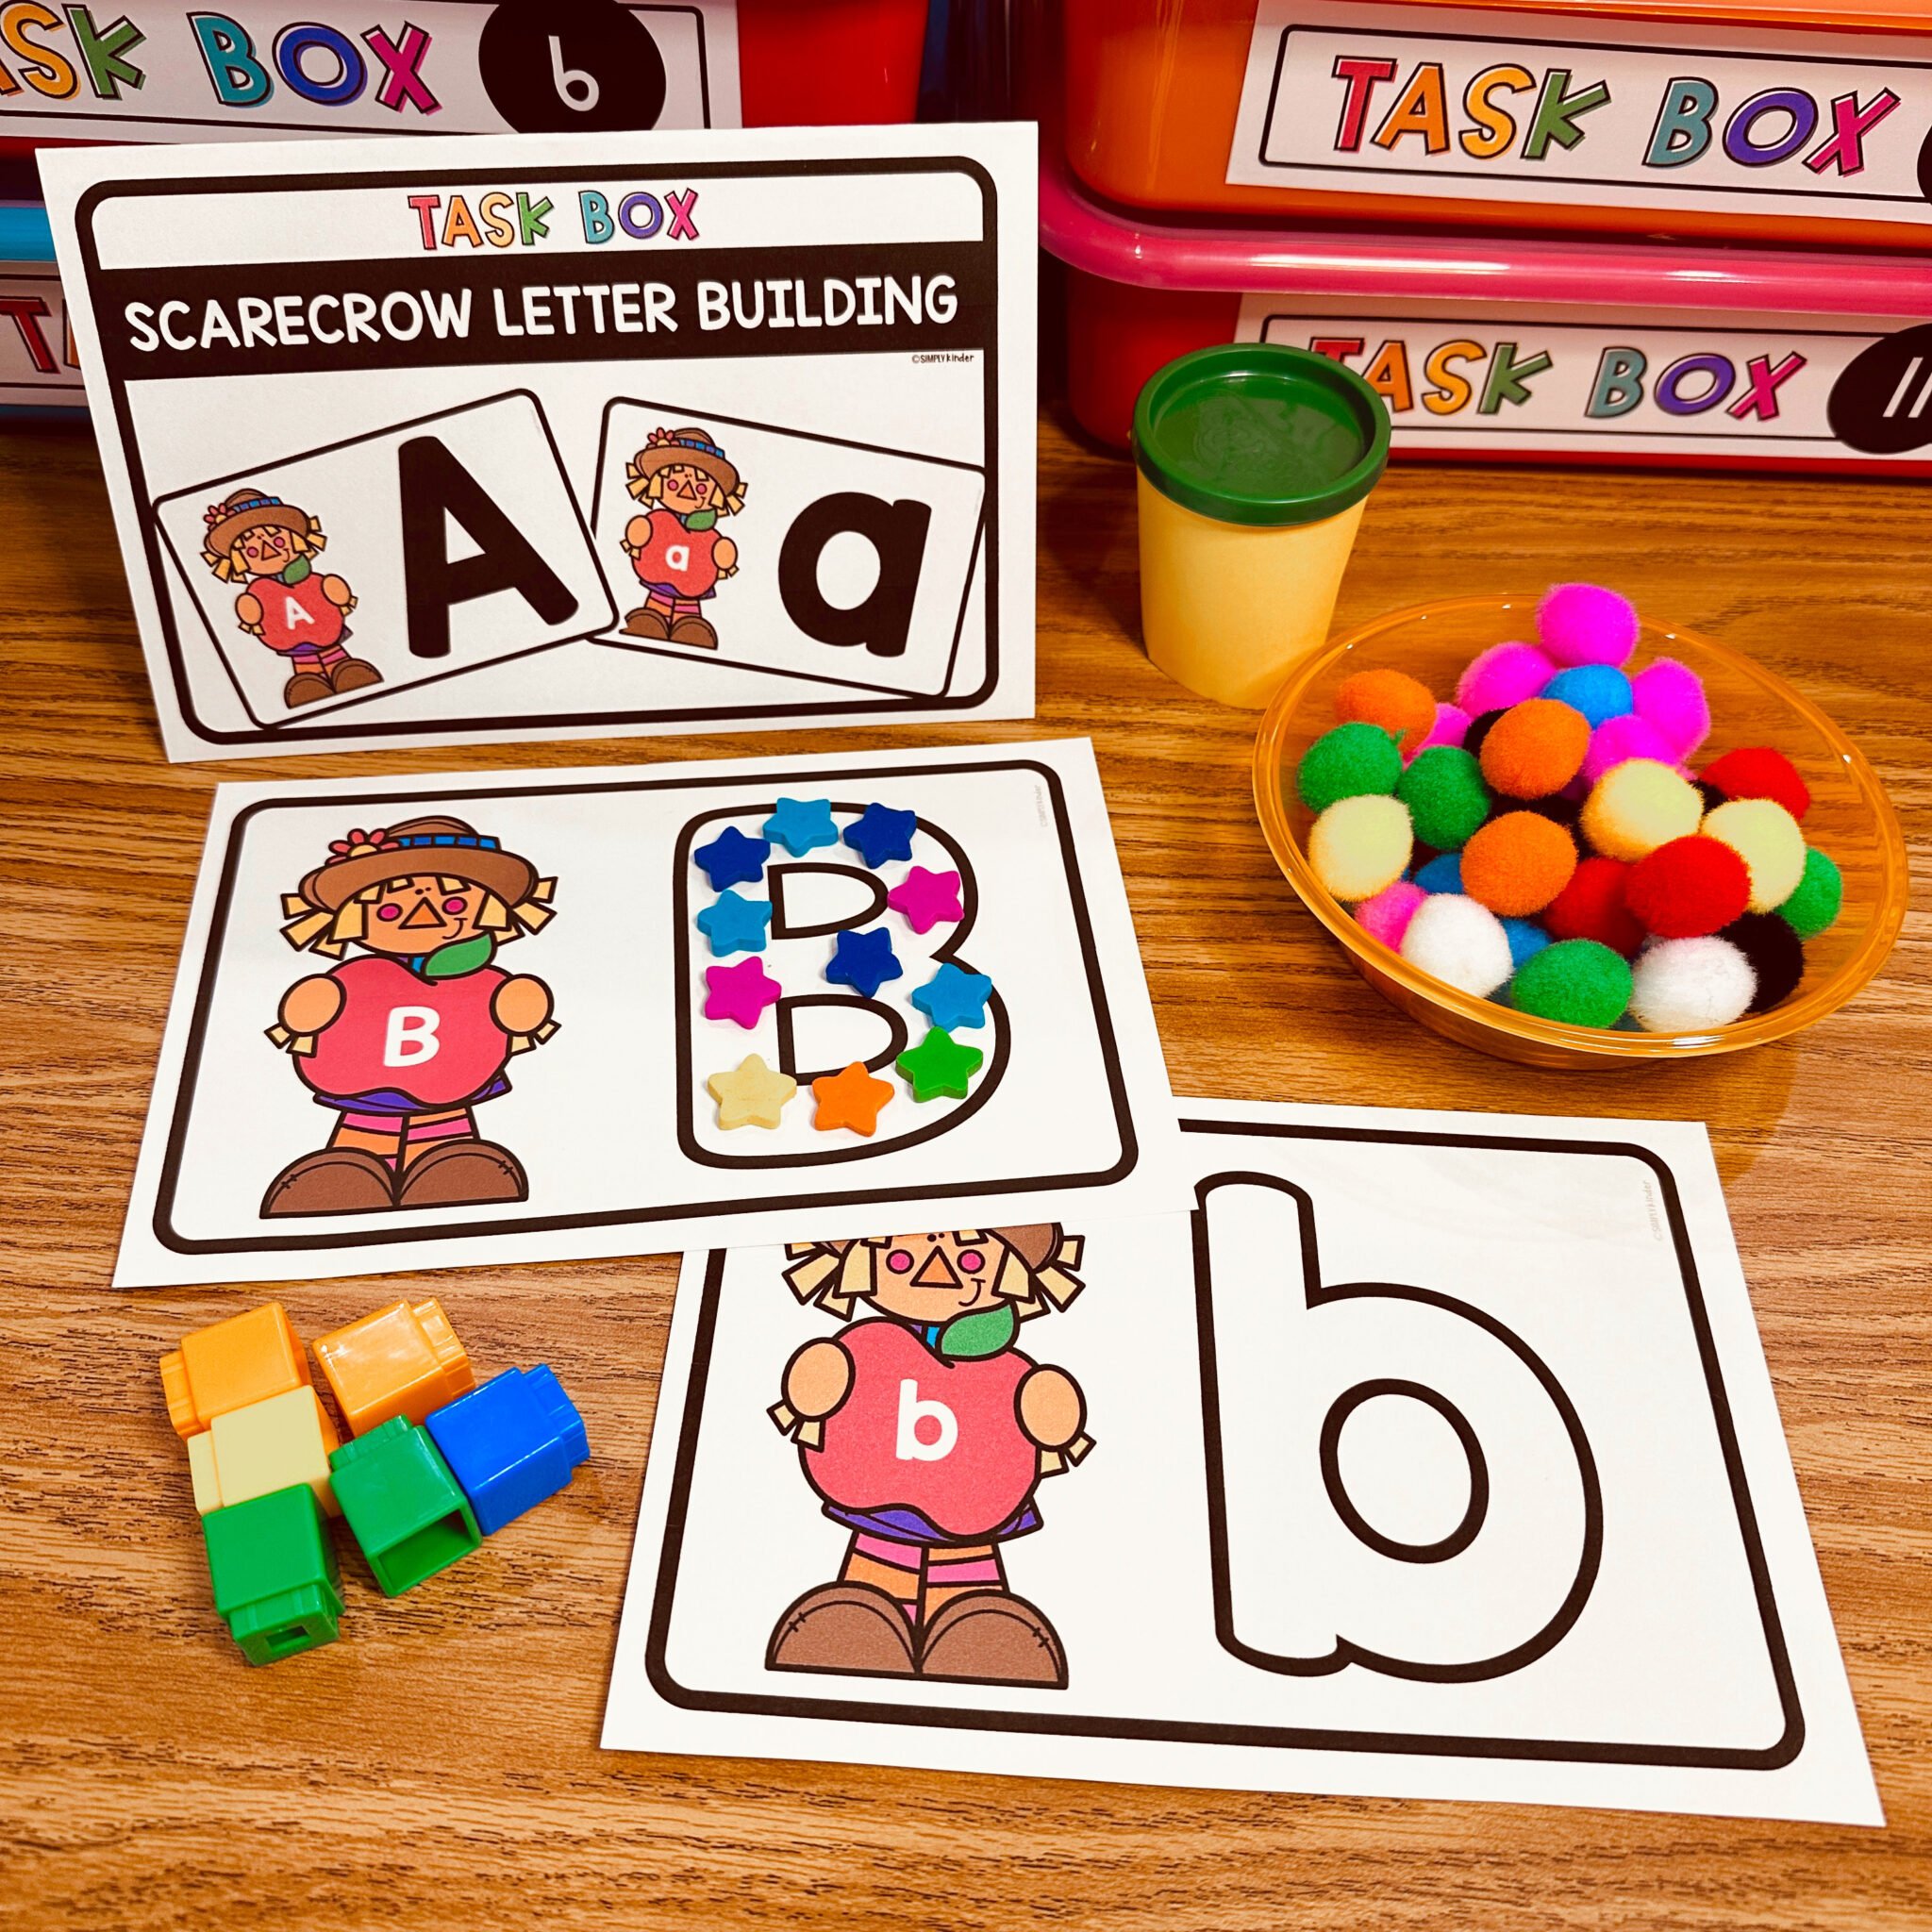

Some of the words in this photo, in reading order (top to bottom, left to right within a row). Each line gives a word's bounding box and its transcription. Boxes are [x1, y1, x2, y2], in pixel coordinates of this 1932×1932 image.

[0, 0, 147, 101] SK
[187, 11, 441, 114] BOX
[1331, 56, 1611, 161] TASK
[1641, 76, 1902, 176] BOX
[408, 191, 554, 250] TASK
[579, 188, 699, 245] BOX
[125, 288, 472, 352] SCARECROW
[493, 281, 678, 338] LETTER
[697, 275, 958, 330] BUILDING
[1584, 346, 1807, 422] BOX
[397, 435, 579, 658] A
[665, 541, 690, 574] a
[777, 491, 933, 658] a
[284, 595, 315, 632] A
[674, 800, 1011, 1170] B
[383, 1006, 441, 1067] B
[894, 1379, 958, 1462] b
[1192, 1170, 1604, 1684] b
